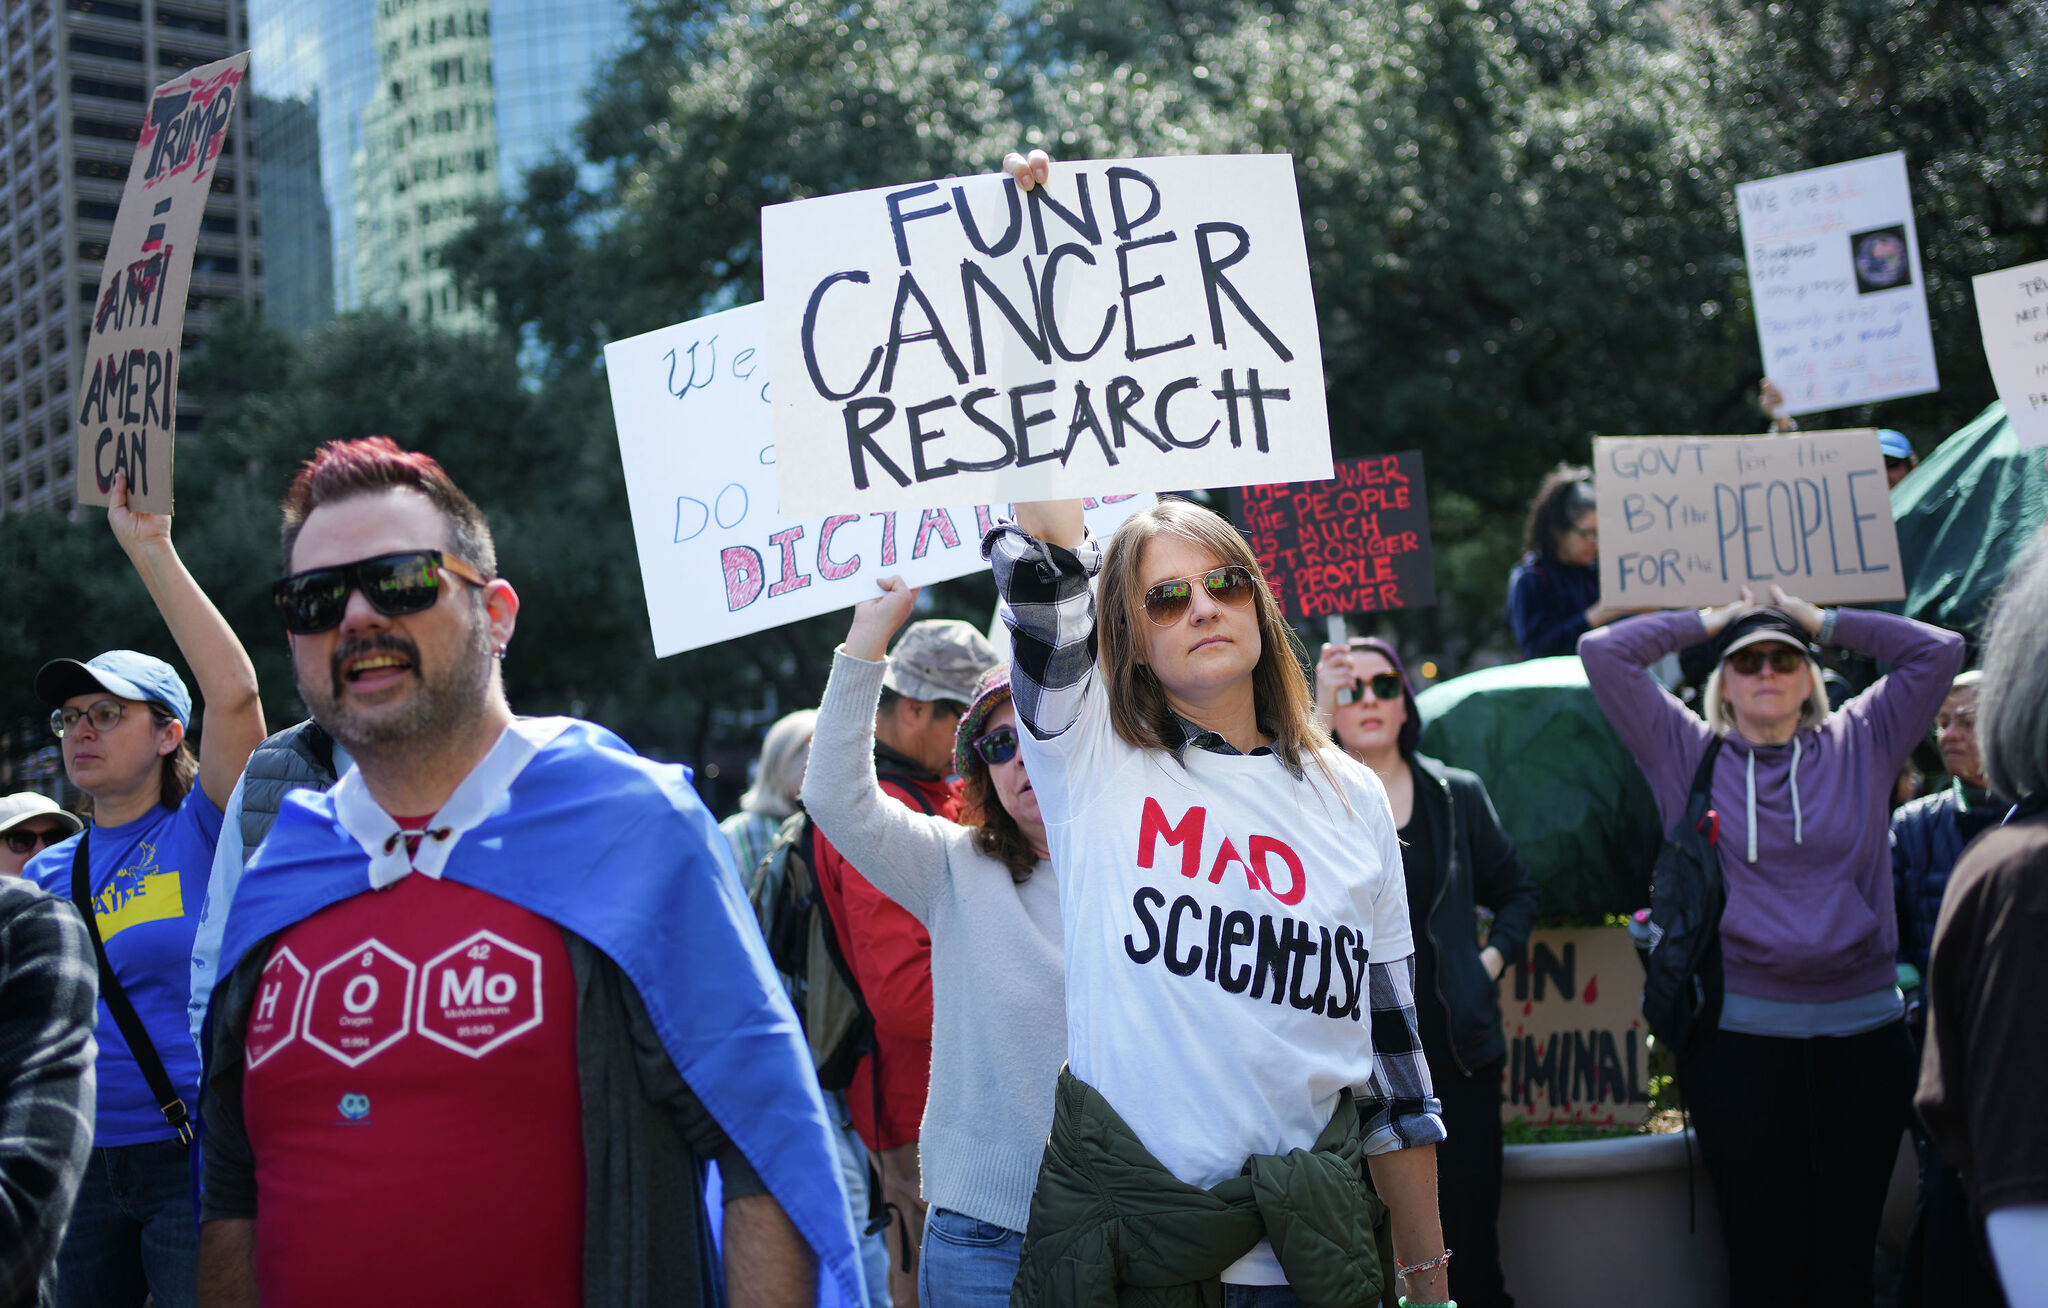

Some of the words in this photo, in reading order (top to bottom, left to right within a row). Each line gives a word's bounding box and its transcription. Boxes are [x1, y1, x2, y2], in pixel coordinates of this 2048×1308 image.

[145, 87, 232, 180] TRUMP
[886, 167, 1162, 266] FUND
[97, 245, 172, 333] ANTI
[800, 221, 1293, 402] CANCER
[662, 334, 757, 400] We
[80, 348, 173, 431] AMERI
[842, 367, 1292, 490] RESEARCH
[95, 427, 148, 496] CAN
[1304, 455, 1409, 493] OWER
[1610, 443, 1712, 479] GOVT
[1243, 499, 1274, 518] OF
[1245, 511, 1289, 533] THE
[1293, 485, 1411, 524] PEOPLE
[1251, 531, 1278, 553] IS
[1297, 512, 1381, 544] MUCH
[1623, 493, 1679, 533] BY
[1714, 469, 1890, 583] PEOPLE
[720, 494, 1137, 612] DICTAT
[1618, 549, 1686, 591] FOR
[1294, 555, 1398, 595] PEOPLE
[1300, 583, 1405, 617] POWER
[1137, 796, 1306, 906] MAD
[276, 959, 283, 972] 1
[361, 952, 373, 967] 8
[467, 944, 490, 960] 42
[257, 981, 281, 1020] H
[343, 974, 379, 1014] O
[440, 966, 517, 1008] Mo
[1502, 1029, 1650, 1107] IMINAL
